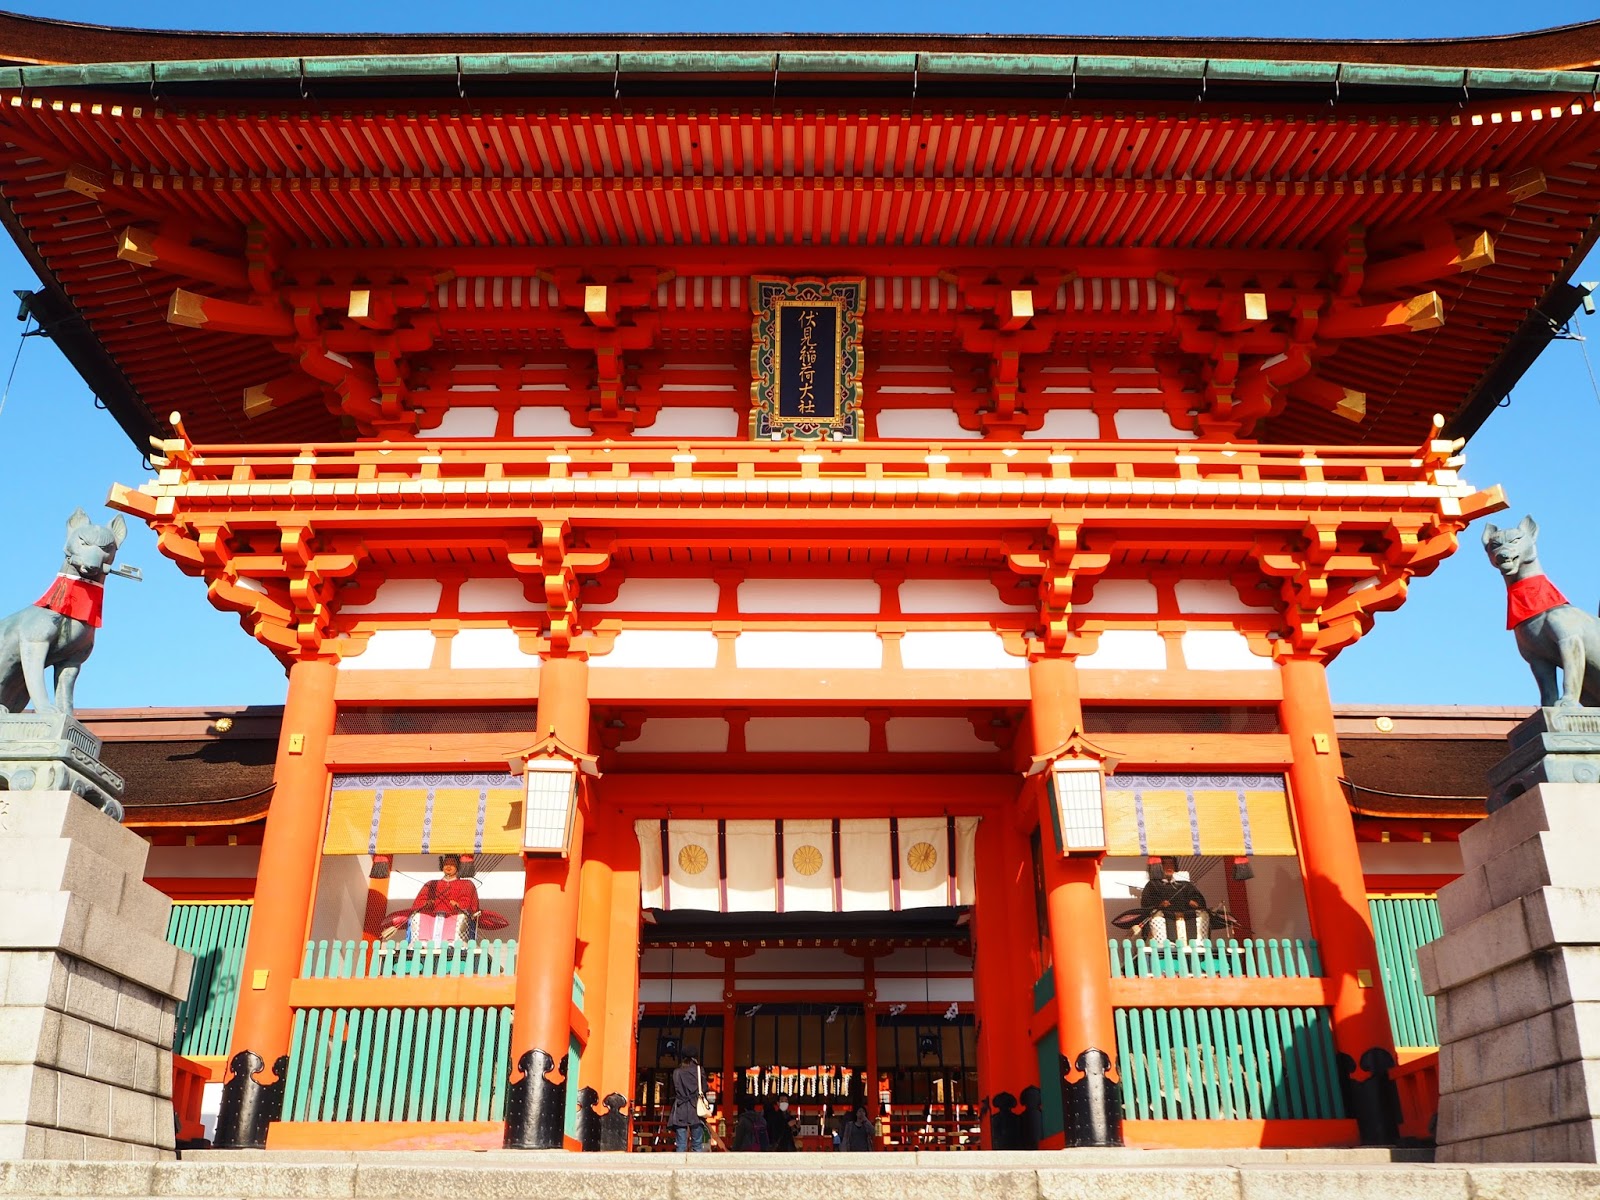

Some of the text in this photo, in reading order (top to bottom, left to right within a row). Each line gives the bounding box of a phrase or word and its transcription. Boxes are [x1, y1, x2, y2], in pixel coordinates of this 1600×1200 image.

[798, 310, 819, 414] 伏見稲荷大社
